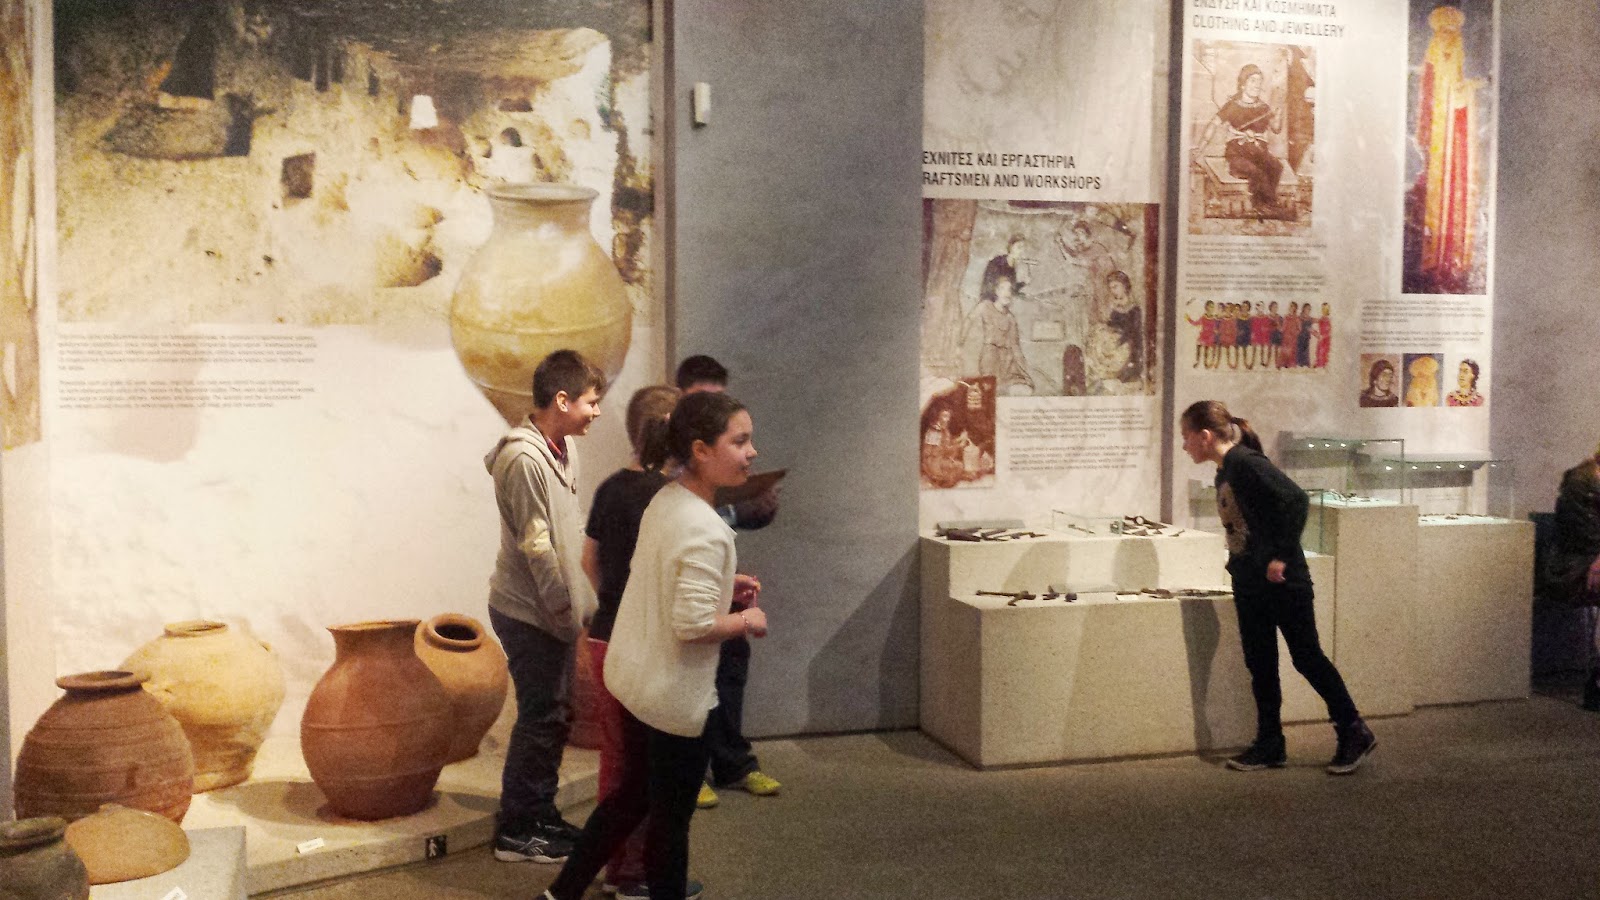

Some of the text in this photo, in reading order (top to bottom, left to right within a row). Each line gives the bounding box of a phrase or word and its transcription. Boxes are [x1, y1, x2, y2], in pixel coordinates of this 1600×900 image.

[1243, 0, 1262, 12] ΚΑΙ
[1266, 0, 1337, 17] ΚΟΣΜΗΜΑΤΑ
[1192, 14, 1345, 38] CLOTHING AND JEWELLERY
[922, 150, 1076, 169] ΕΧΝΙΤΕΣ ΚΑΙ ΕΡΓΑΣΤΗΡΙΑ
[922, 171, 1101, 190] RAFTSMEN AND WORKSHOPS
